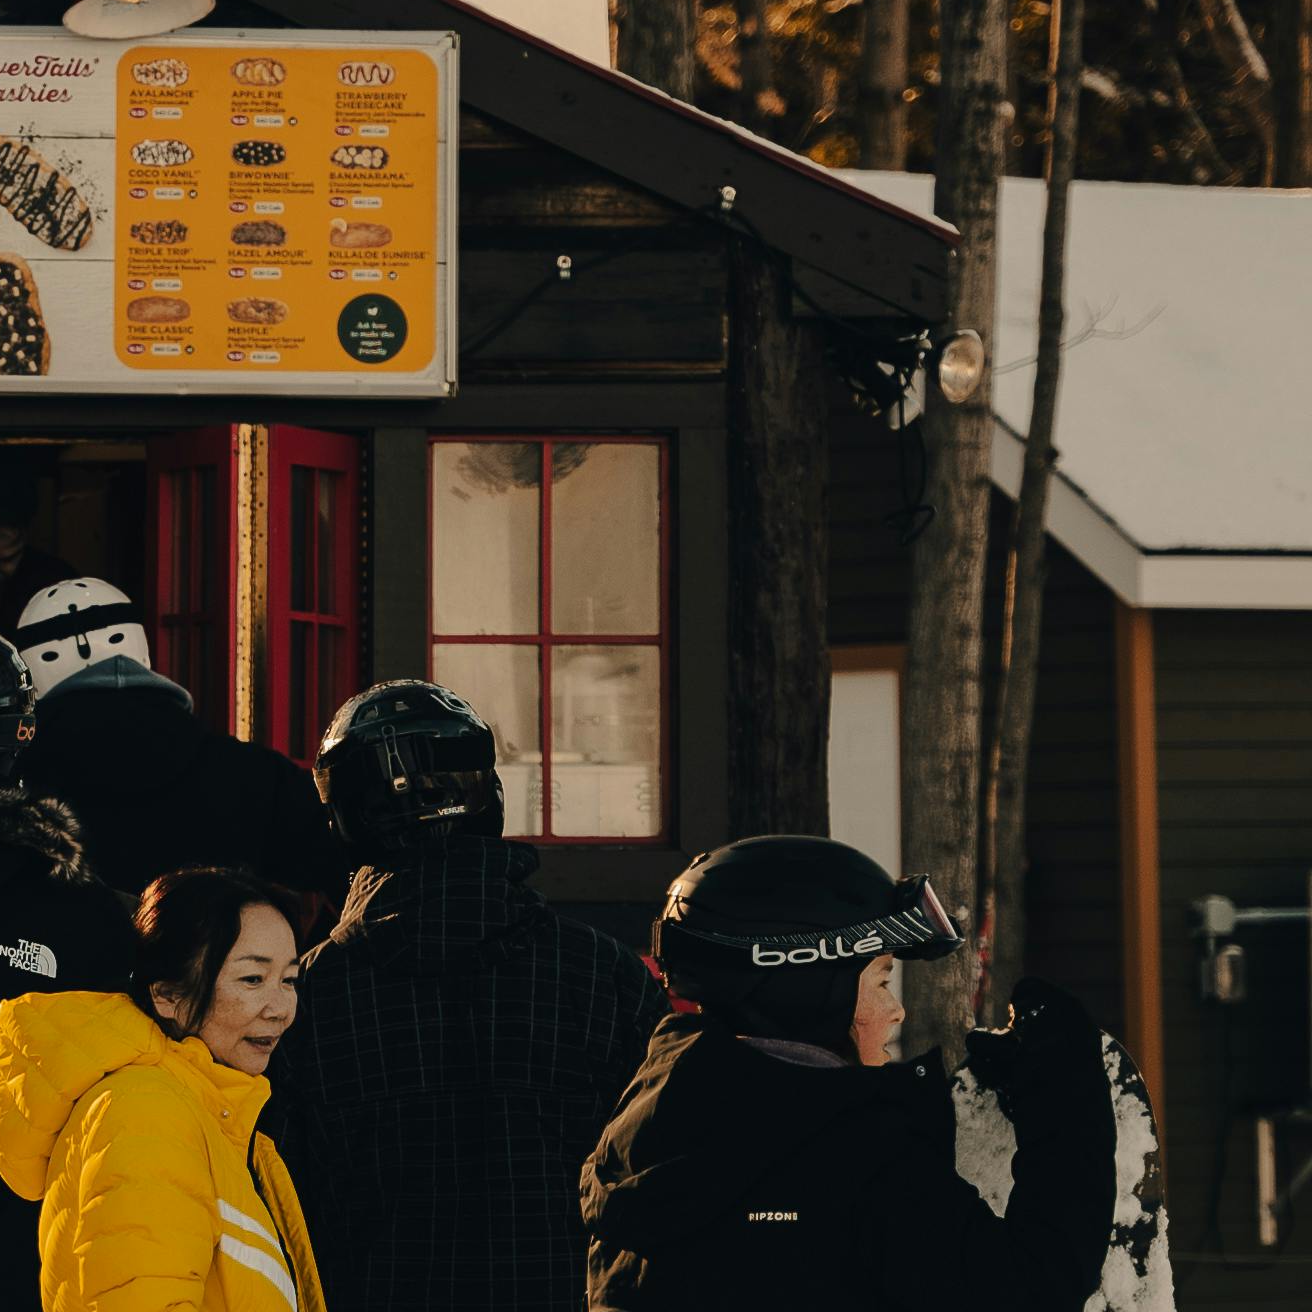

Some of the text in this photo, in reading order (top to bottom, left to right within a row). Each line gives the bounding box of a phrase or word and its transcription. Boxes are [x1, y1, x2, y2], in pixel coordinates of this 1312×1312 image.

[128, 169, 160, 178] COCO
[127, 325, 194, 335] THE CLASSIC
[18, 938, 42, 954] THE
[752, 929, 883, 967] bollé
[9, 957, 39, 973] FACE
[748, 1211, 798, 1222] RIPZONE
